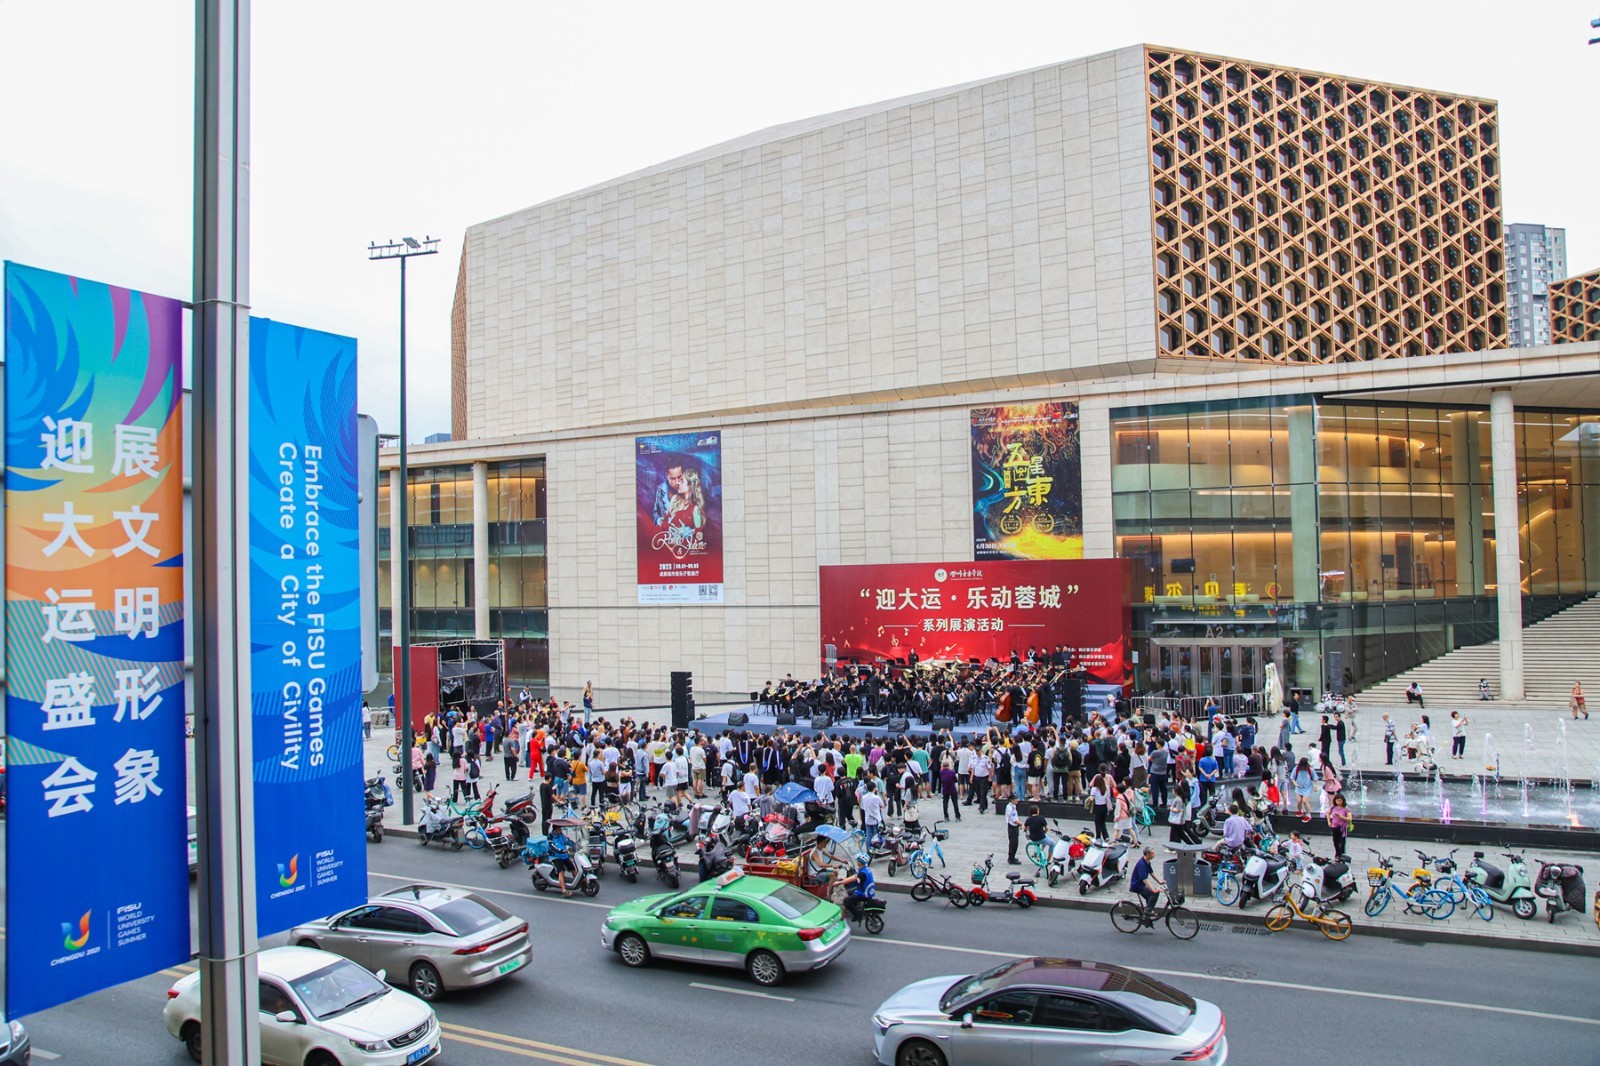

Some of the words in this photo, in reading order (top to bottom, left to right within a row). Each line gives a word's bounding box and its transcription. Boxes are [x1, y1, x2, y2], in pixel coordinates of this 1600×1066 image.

[279, 442, 298, 530] Create
[304, 444, 323, 557] Embrace
[280, 544, 295, 560] a
[306, 564, 325, 606] the
[277, 574, 300, 626] City
[40, 415, 98, 818] 迎大运盛会
[111, 423, 164, 806] 展文明形象
[922, 617, 1004, 632] 系列展演活动
[307, 613, 326, 669] FISU
[281, 640, 301, 667] of
[280, 681, 303, 770] Civility
[308, 677, 327, 768] Games
[316, 856, 335, 866] WORLD
[316, 860, 344, 873] UNIVERSITY
[316, 869, 334, 879] GAMES
[317, 875, 338, 886] SUMMER
[116, 902, 142, 915] FISU
[117, 911, 143, 923] WORLD
[117, 915, 155, 931] UNIVERSITY
[117, 927, 141, 939] GAMES
[117, 933, 147, 947] SUMMER
[50, 950, 86, 967] CHENGDU
